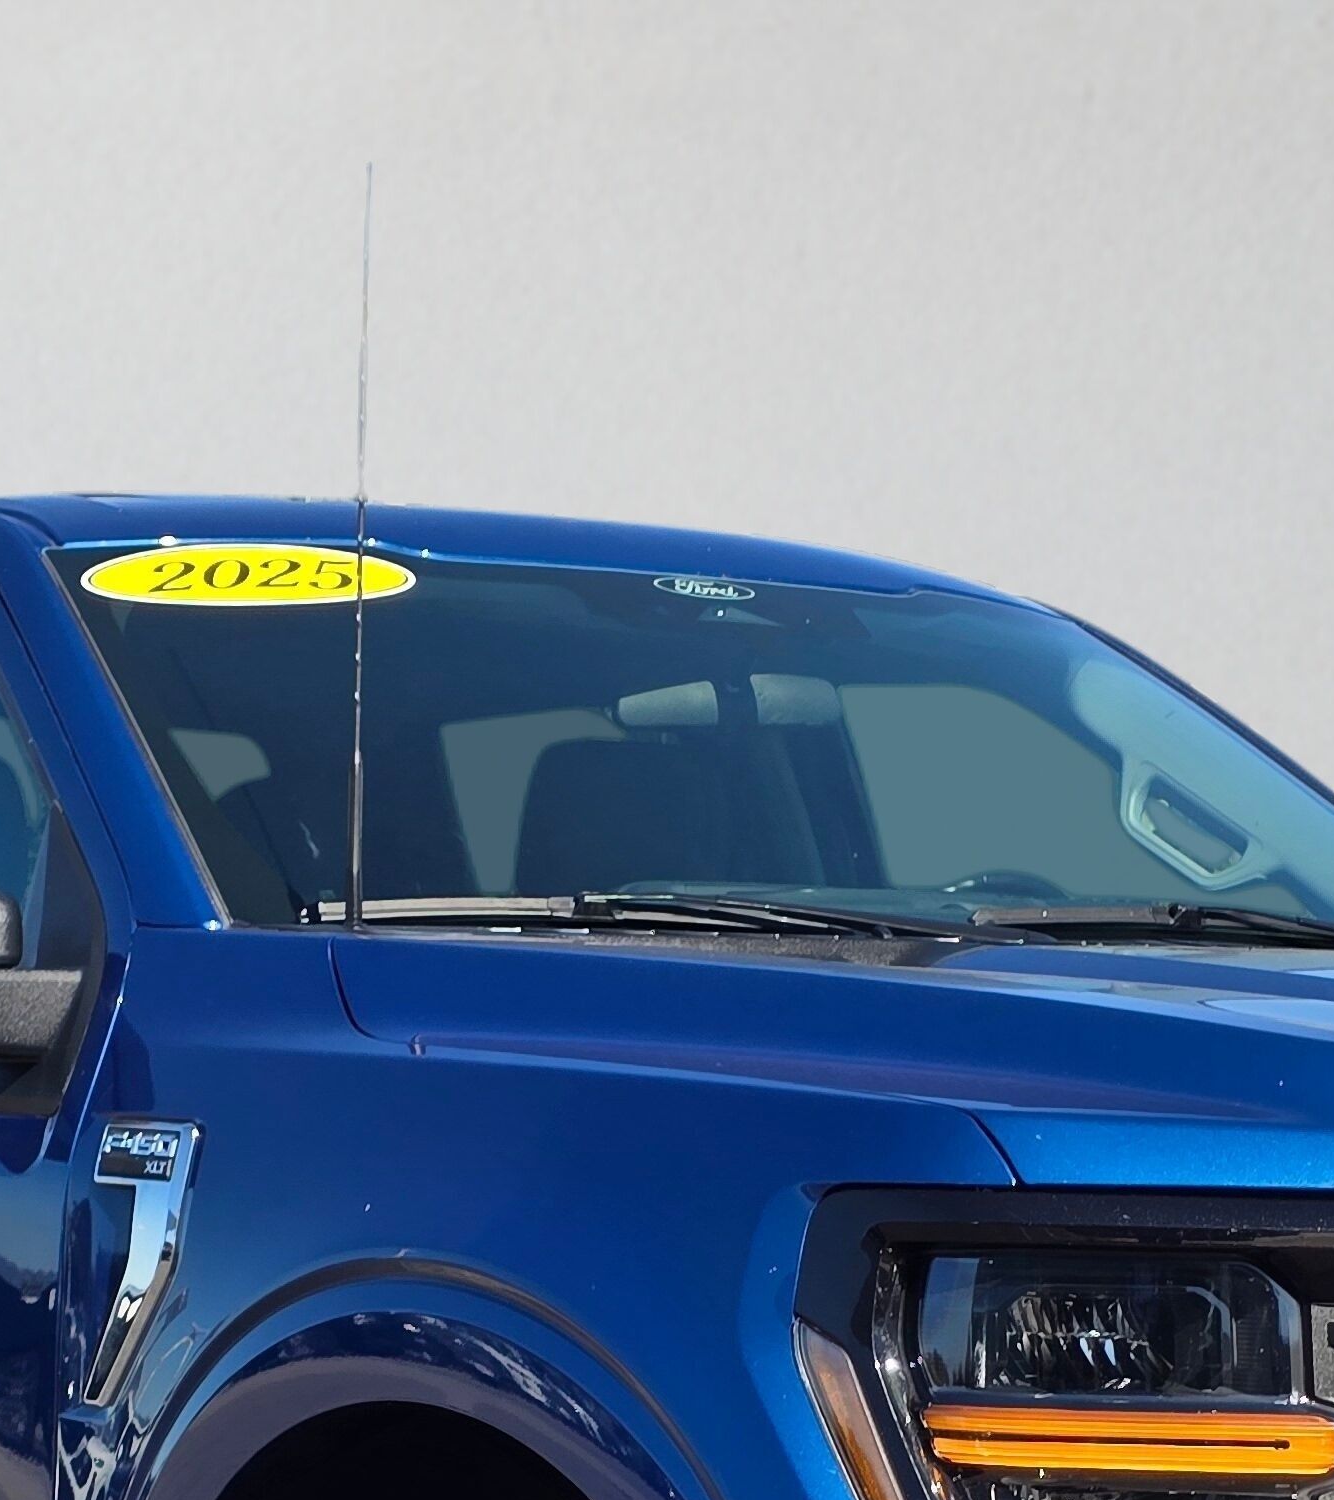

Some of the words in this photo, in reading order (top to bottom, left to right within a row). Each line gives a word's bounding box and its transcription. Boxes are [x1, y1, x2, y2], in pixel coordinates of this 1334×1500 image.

[148, 559, 356, 593] 2025
[674, 578, 738, 598] Ford
[144, 1160, 168, 1174] XLT
